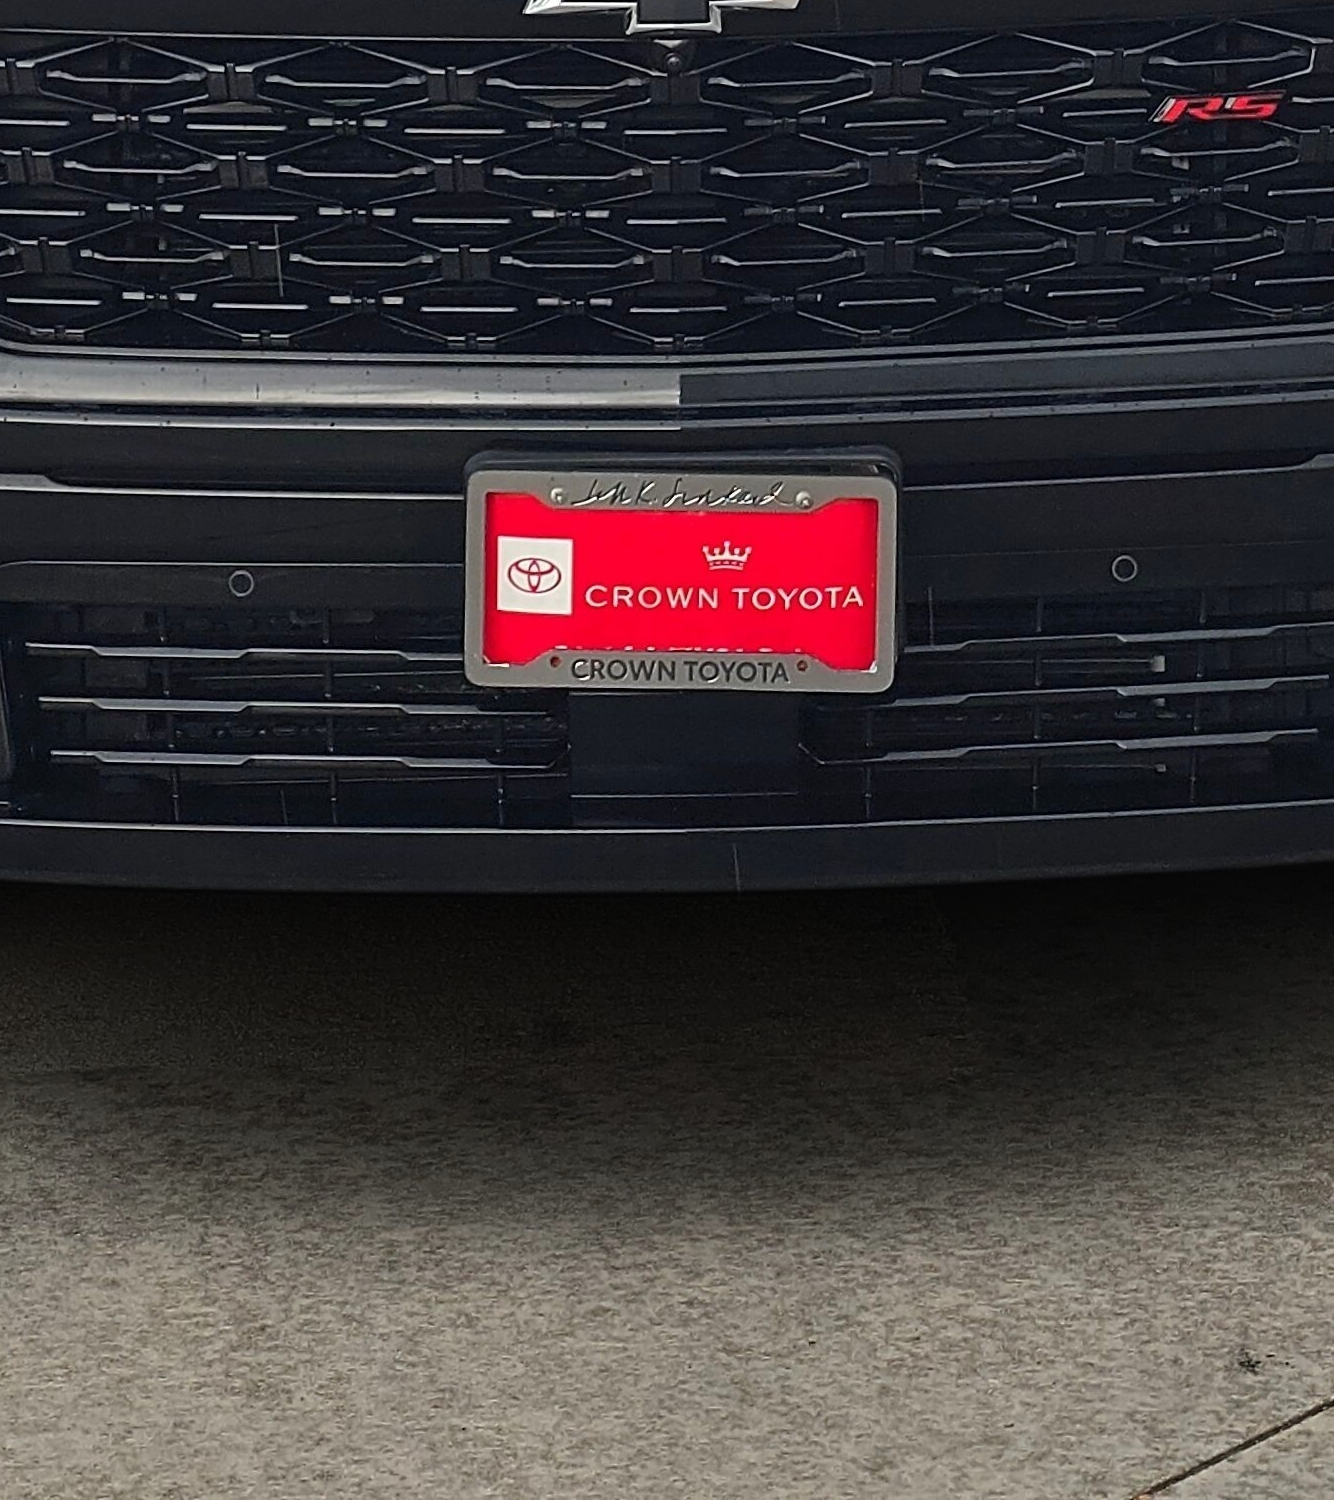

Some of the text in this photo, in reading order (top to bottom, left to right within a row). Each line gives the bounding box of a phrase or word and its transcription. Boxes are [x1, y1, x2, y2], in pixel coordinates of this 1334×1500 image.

[1154, 92, 1284, 123] RS
[585, 585, 865, 610] CROWN TOYOTA
[571, 658, 790, 684] CROWN TOYOTA
